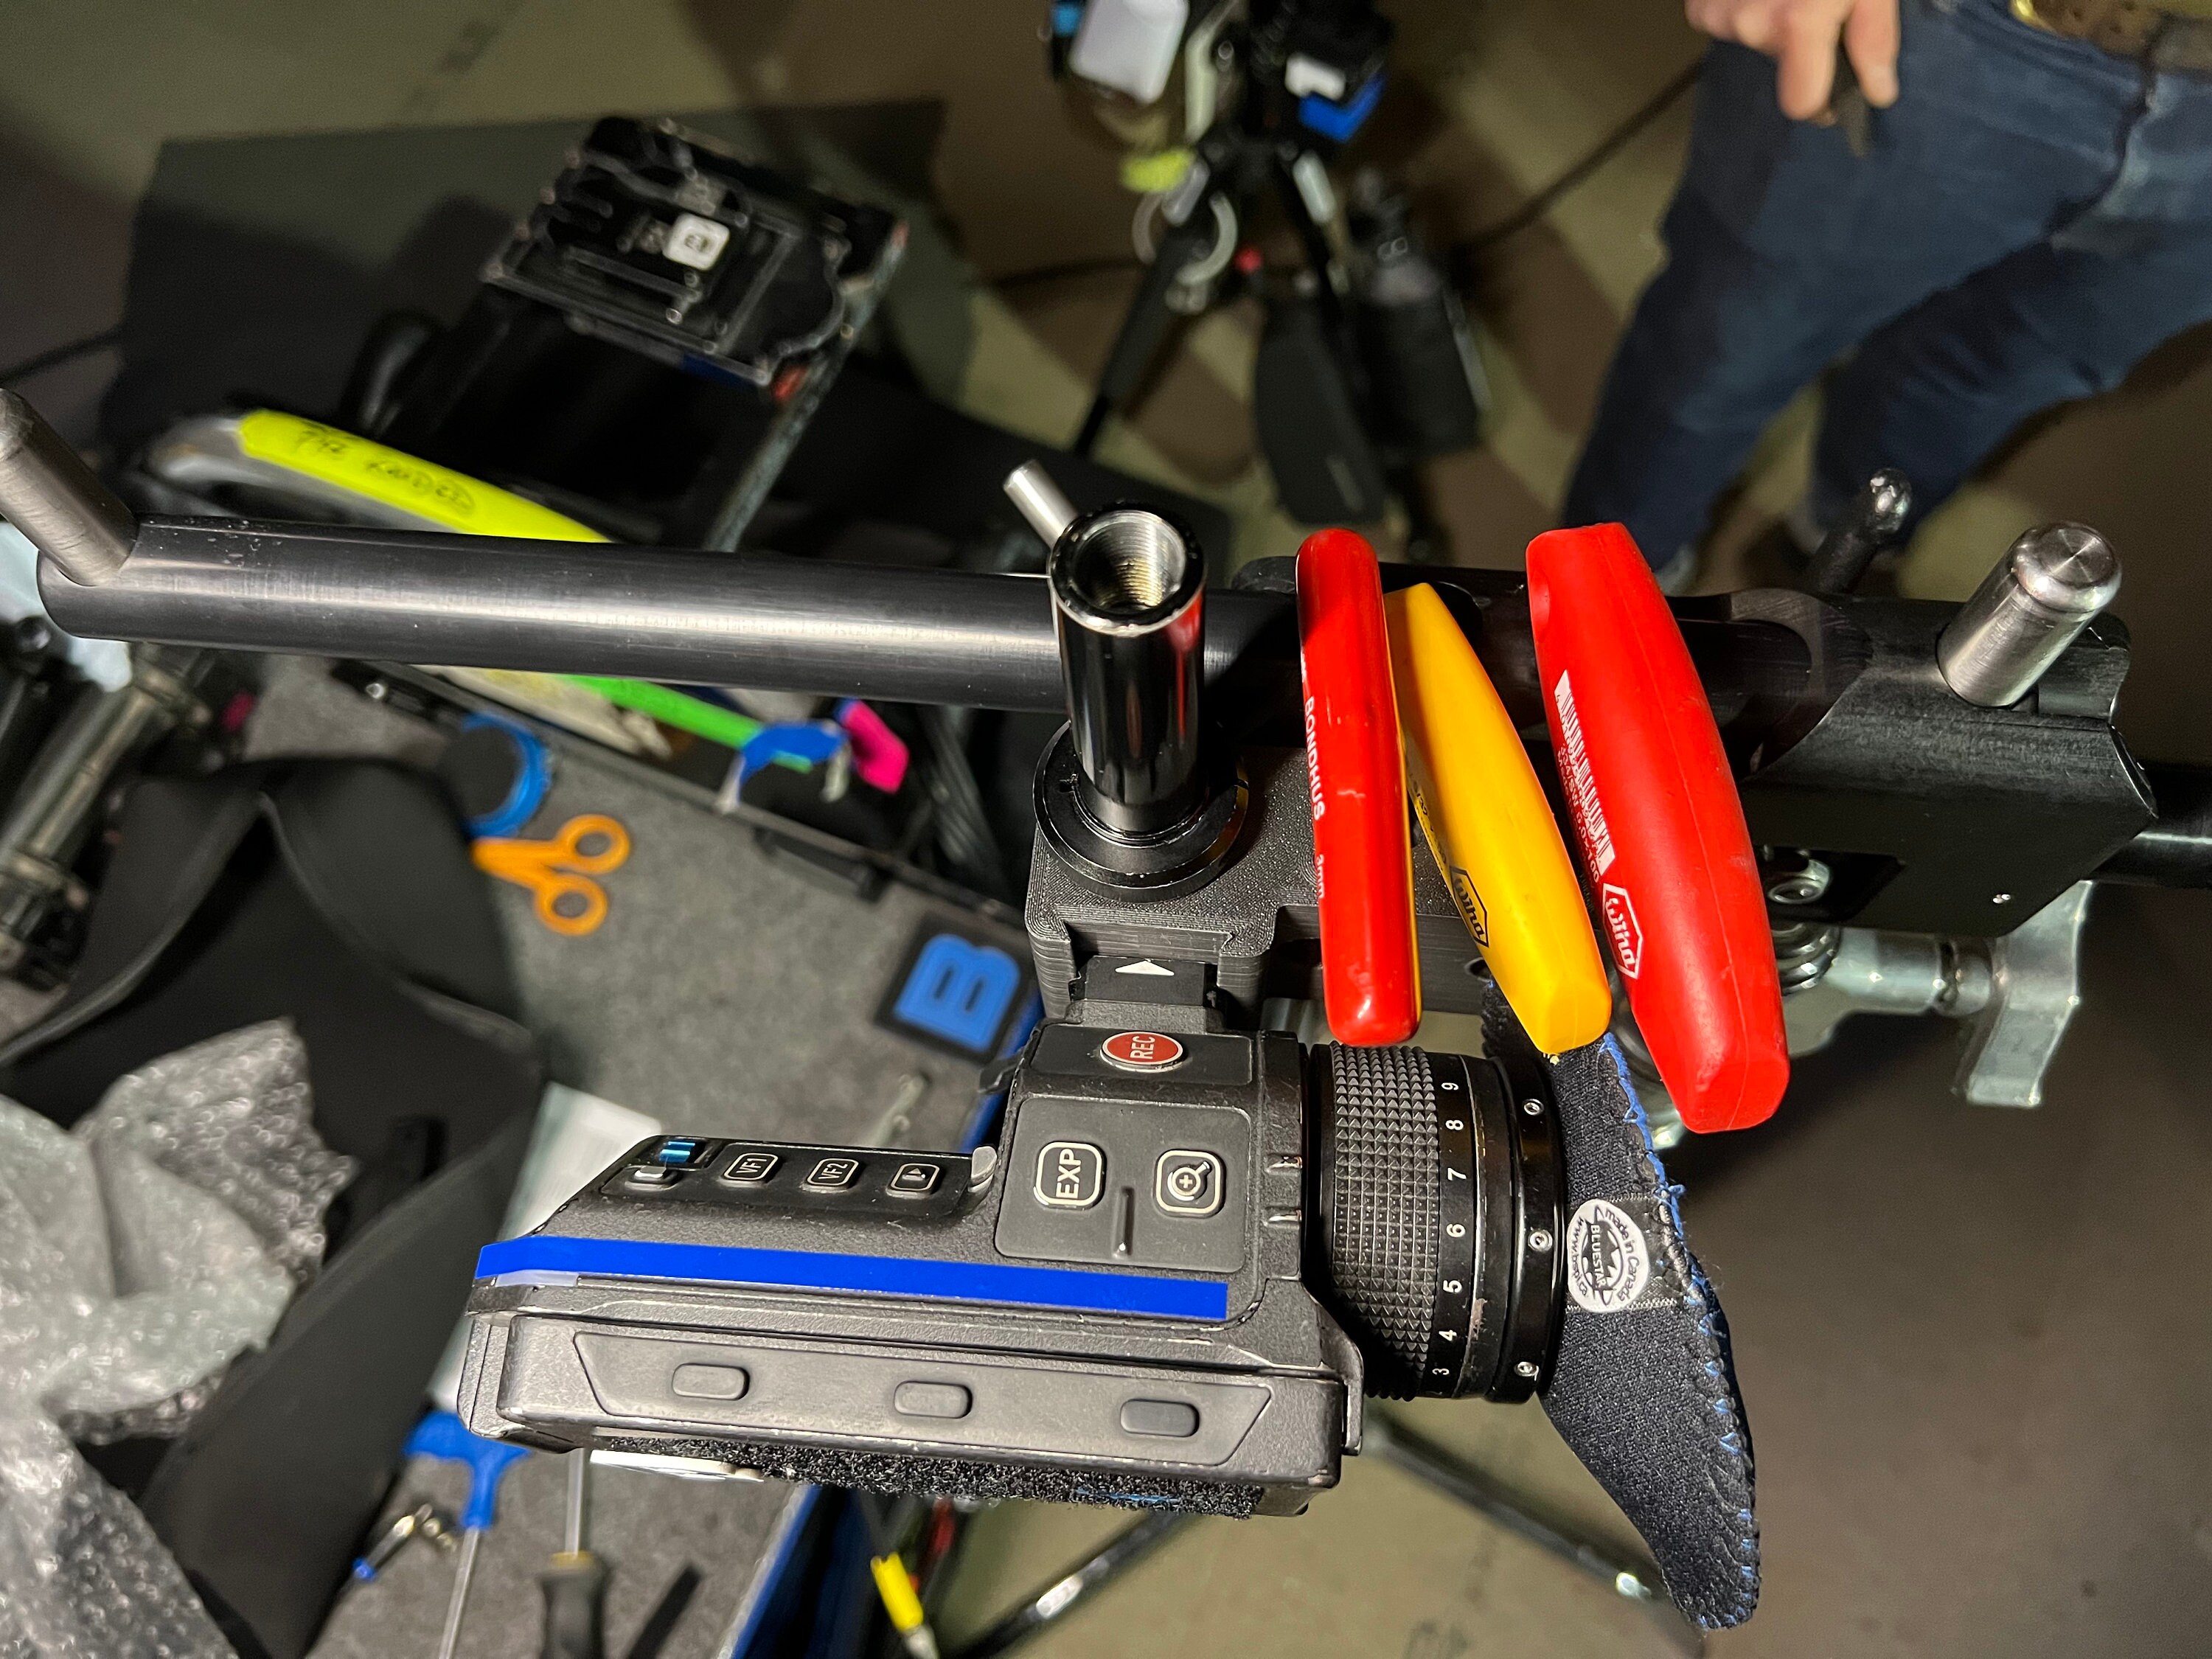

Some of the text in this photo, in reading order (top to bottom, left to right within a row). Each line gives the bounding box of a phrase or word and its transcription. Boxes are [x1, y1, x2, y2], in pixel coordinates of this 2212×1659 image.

[1304, 695, 1325, 820] BONDHUS
[891, 933, 1021, 1053] B
[1130, 1035, 1155, 1060] REC
[736, 1158, 768, 1174] VF1
[818, 1163, 849, 1180] VF2
[1055, 1148, 1082, 1199] EXP
[1432, 1082, 1467, 1376] 3 4 5 6 7 8 9
[1590, 1225, 1607, 1286] BLUESTAR
[1605, 1208, 1640, 1301] made in Canada
